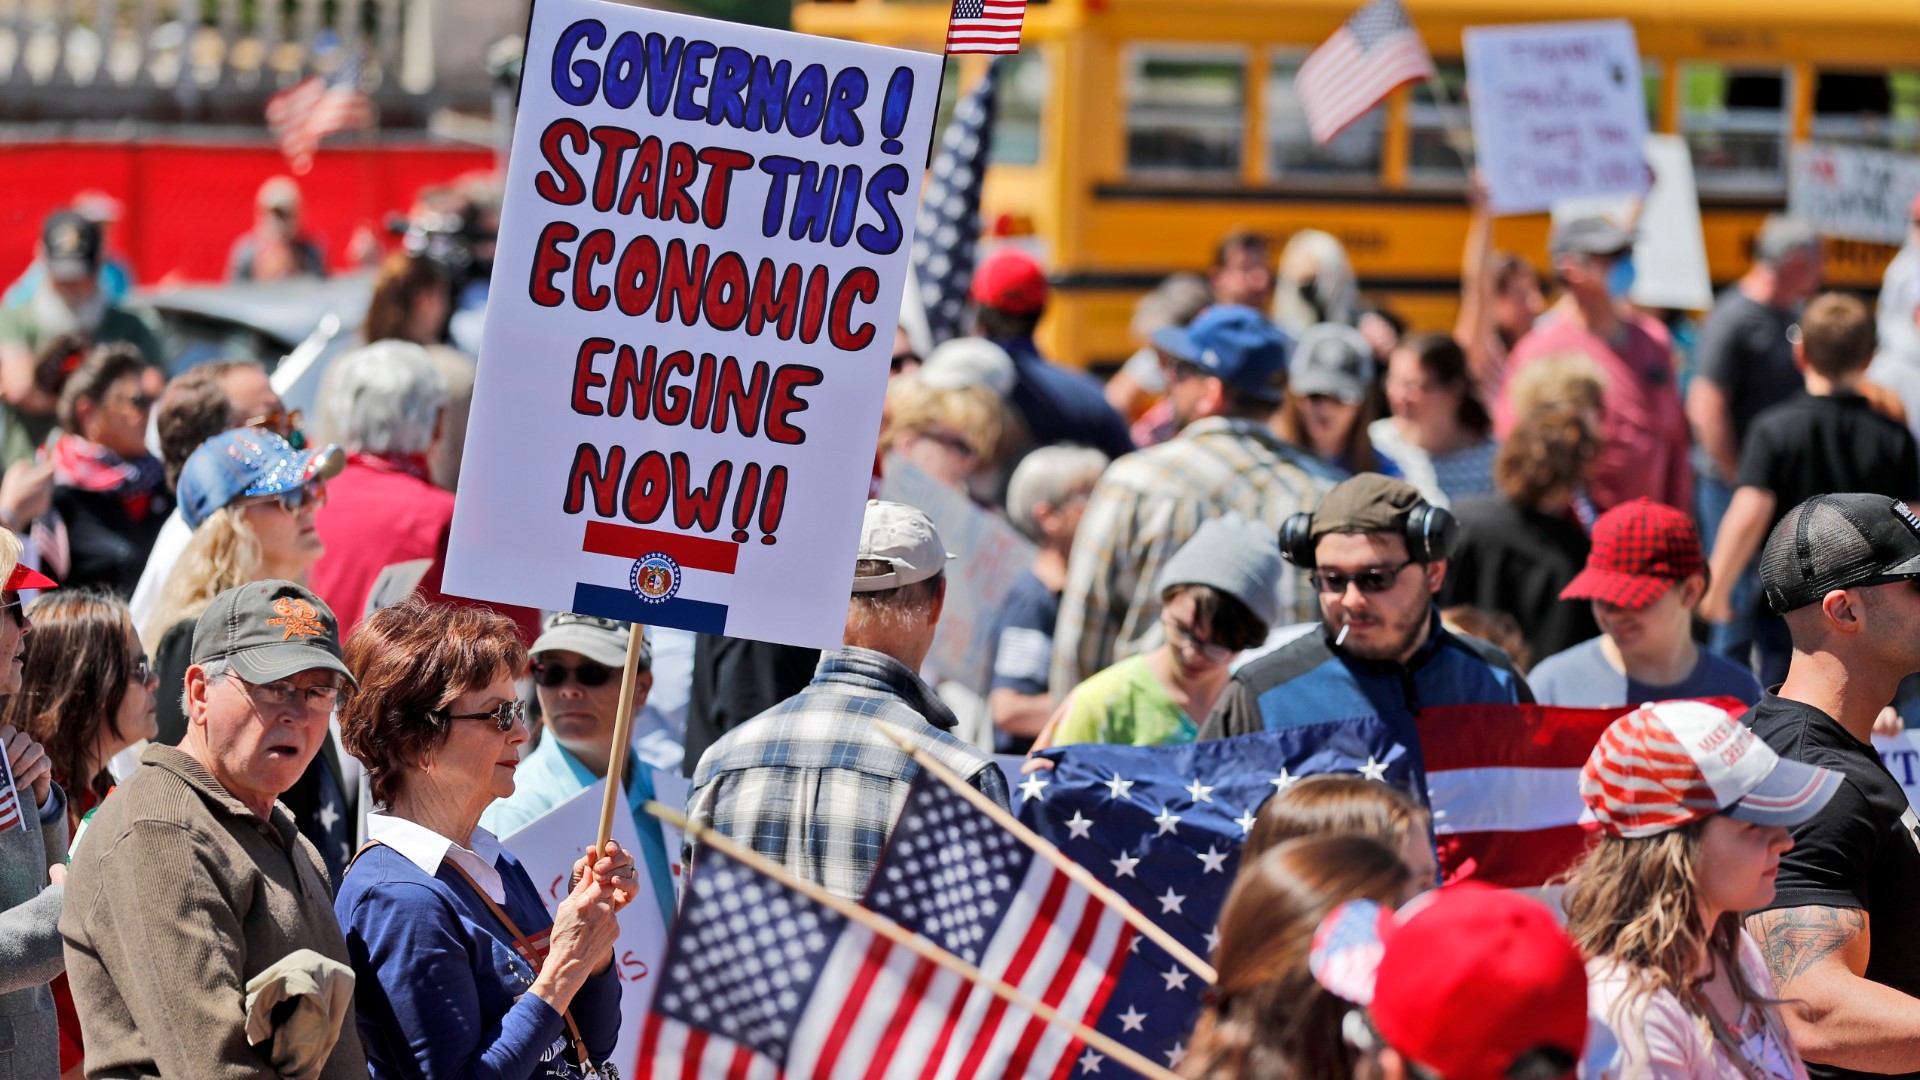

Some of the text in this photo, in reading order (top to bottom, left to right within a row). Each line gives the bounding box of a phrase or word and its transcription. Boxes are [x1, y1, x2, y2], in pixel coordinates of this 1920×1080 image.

[535, 119, 909, 254] START THIS
[530, 221, 880, 351] ECONOMIC
[572, 338, 823, 445] ENGINE
[563, 443, 788, 545] NOW!!
